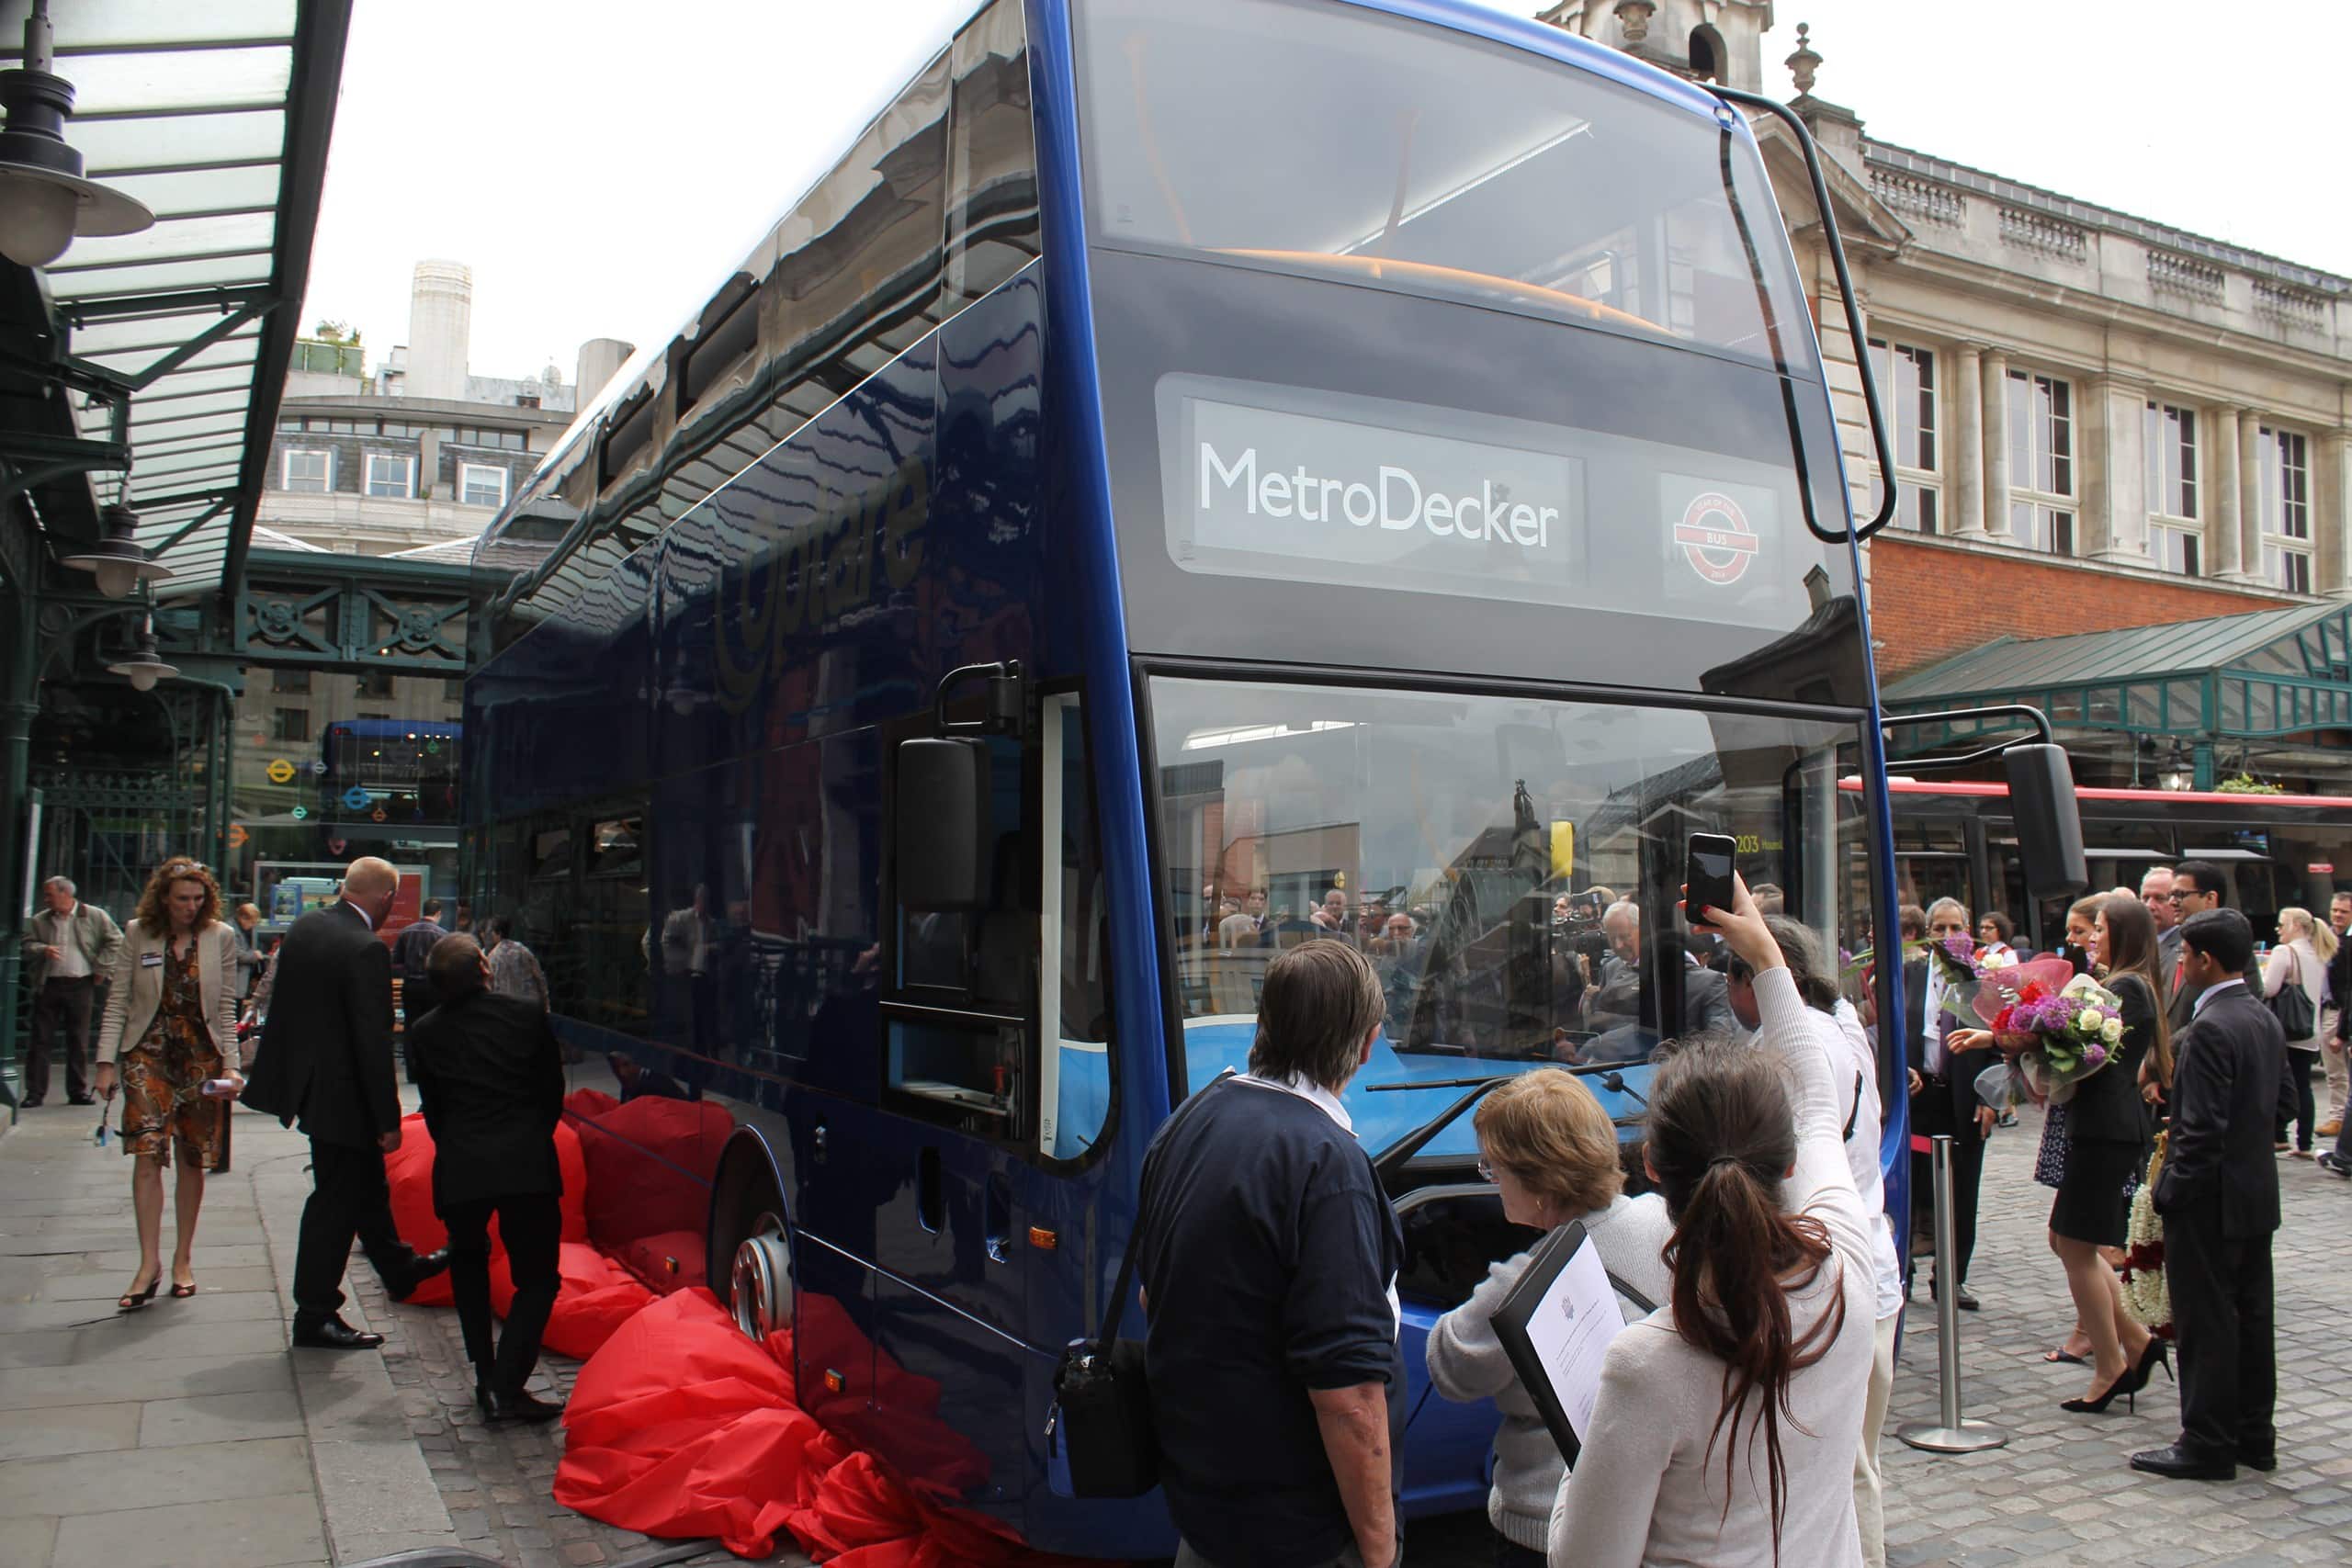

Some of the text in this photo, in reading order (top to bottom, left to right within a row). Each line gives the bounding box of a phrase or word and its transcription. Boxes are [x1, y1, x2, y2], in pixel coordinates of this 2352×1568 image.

[1201, 442, 1558, 547] MetroDecker
[1706, 532, 1727, 545] BUS
[715, 455, 928, 713] Optare
[1736, 835, 1759, 852] 203
